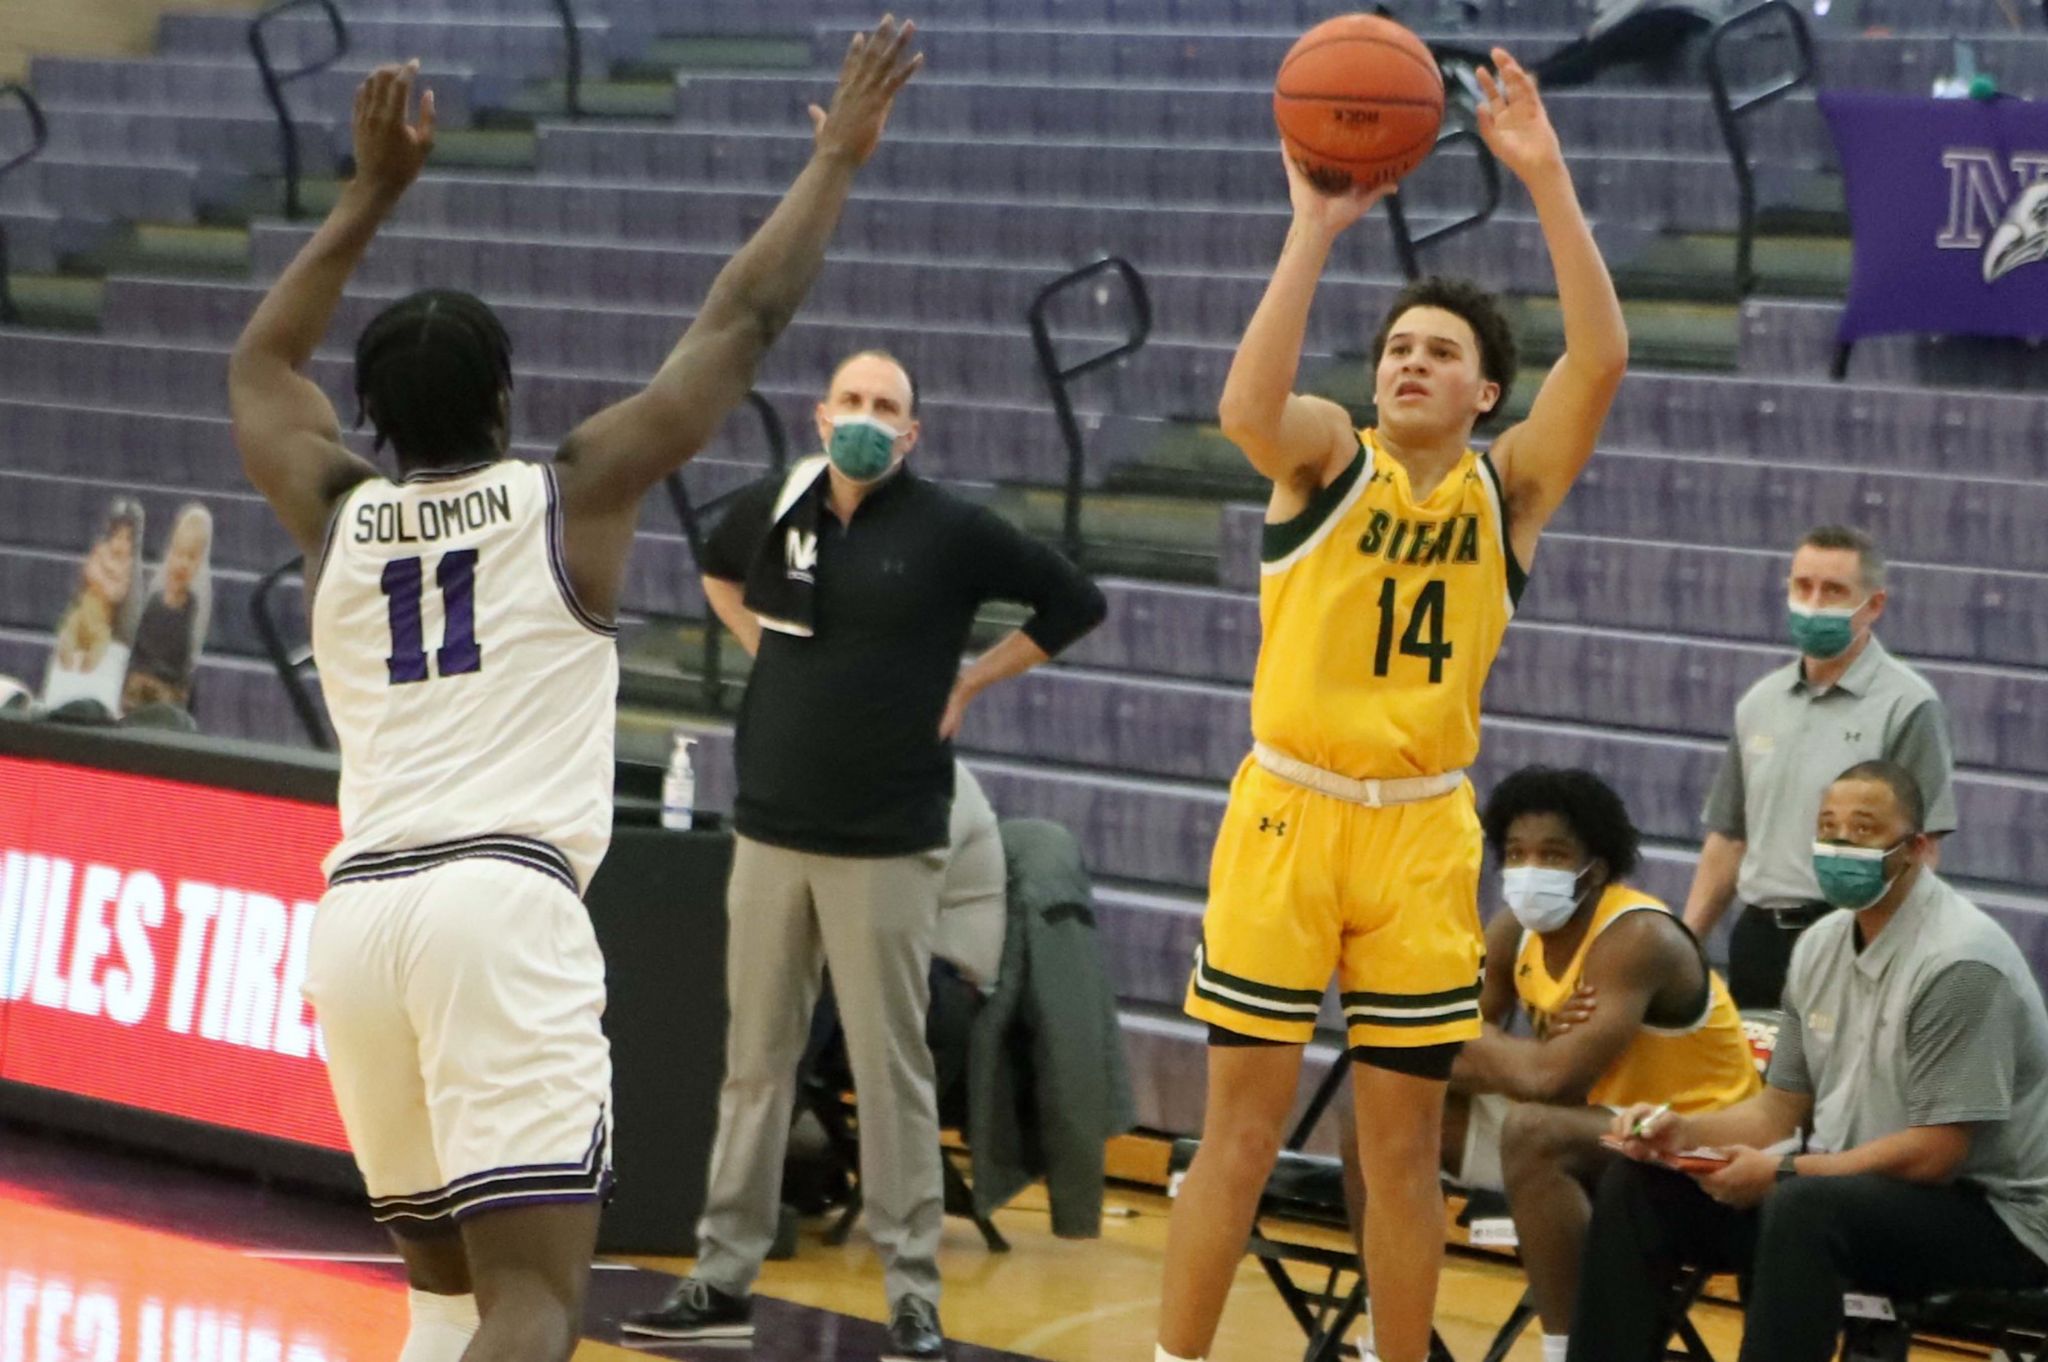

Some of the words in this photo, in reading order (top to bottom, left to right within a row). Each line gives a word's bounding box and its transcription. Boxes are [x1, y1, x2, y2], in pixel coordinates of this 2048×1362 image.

[354, 484, 512, 543] SOLOMON
[1357, 509, 1480, 566] SIENA
[380, 549, 482, 685] 11
[1374, 577, 1453, 683] 14
[168, 879, 328, 1062] TIRE
